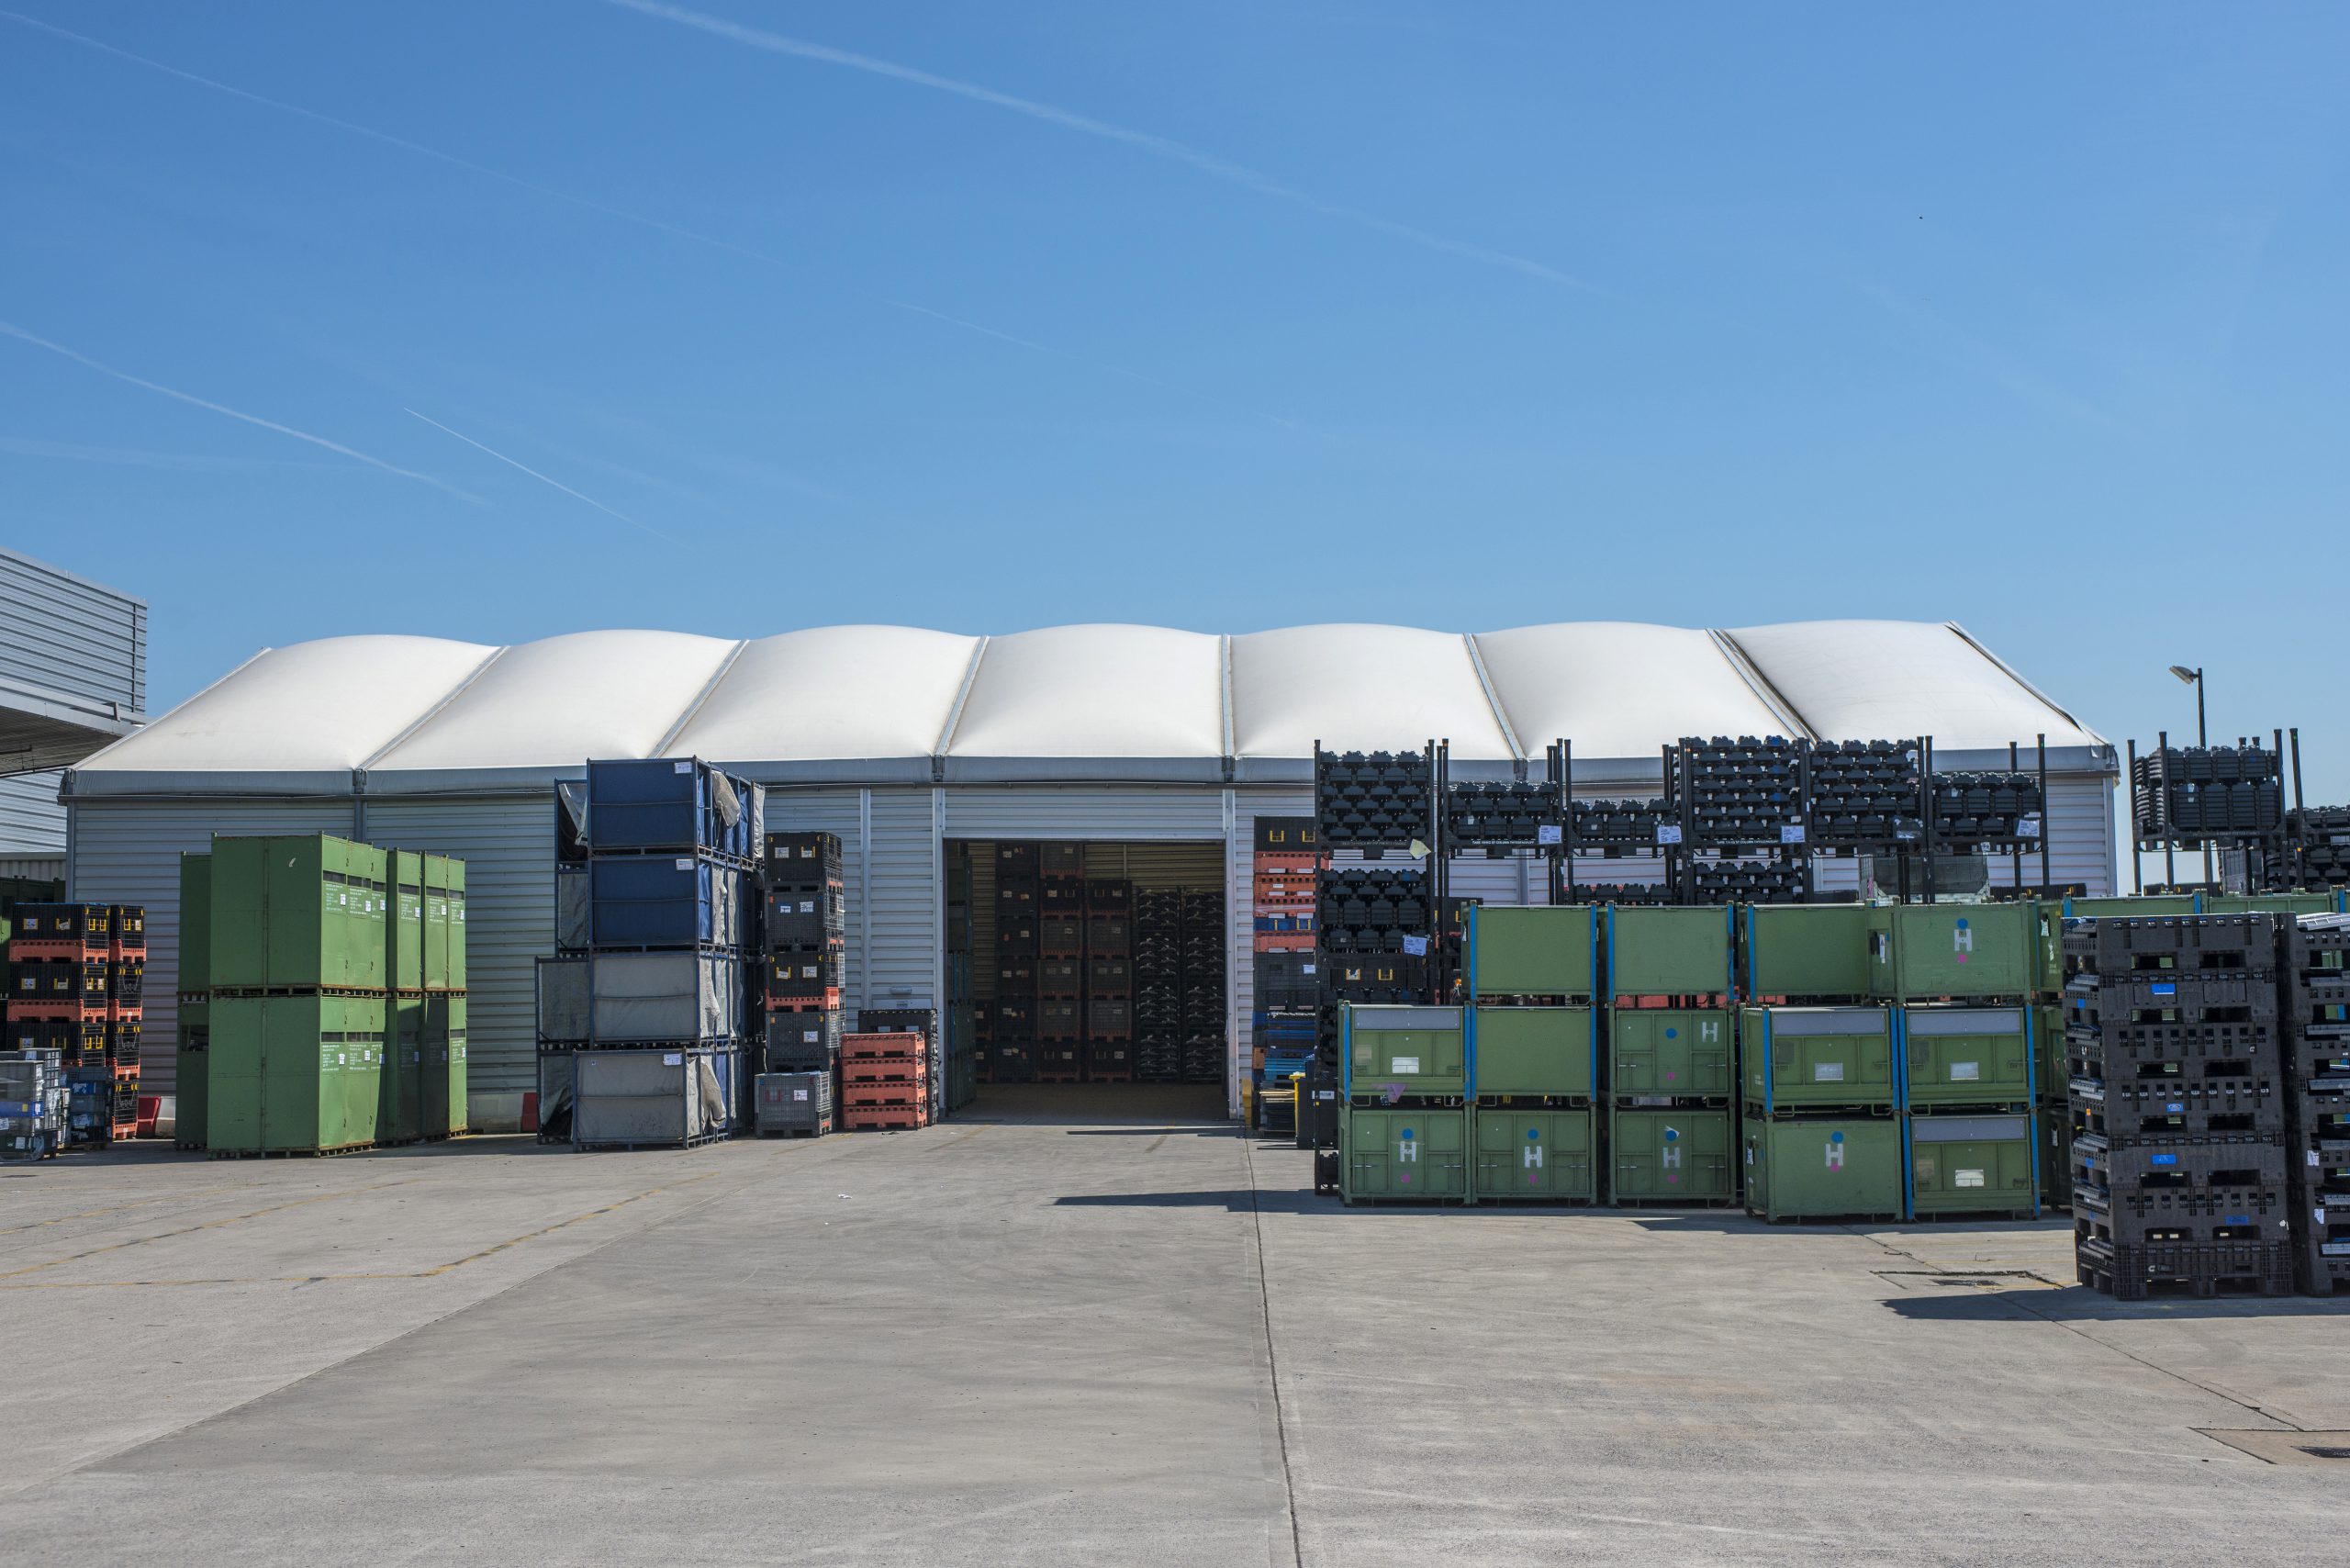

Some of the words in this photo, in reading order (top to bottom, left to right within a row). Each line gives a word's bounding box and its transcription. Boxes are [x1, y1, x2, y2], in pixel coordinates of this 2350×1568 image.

[1953, 928, 1973, 952] H
[1701, 1022, 1718, 1043] H
[1399, 1141, 1417, 1162] H
[1524, 1146, 1543, 1168] H
[1662, 1147, 1681, 1169] H
[1825, 1143, 1844, 1167] H
